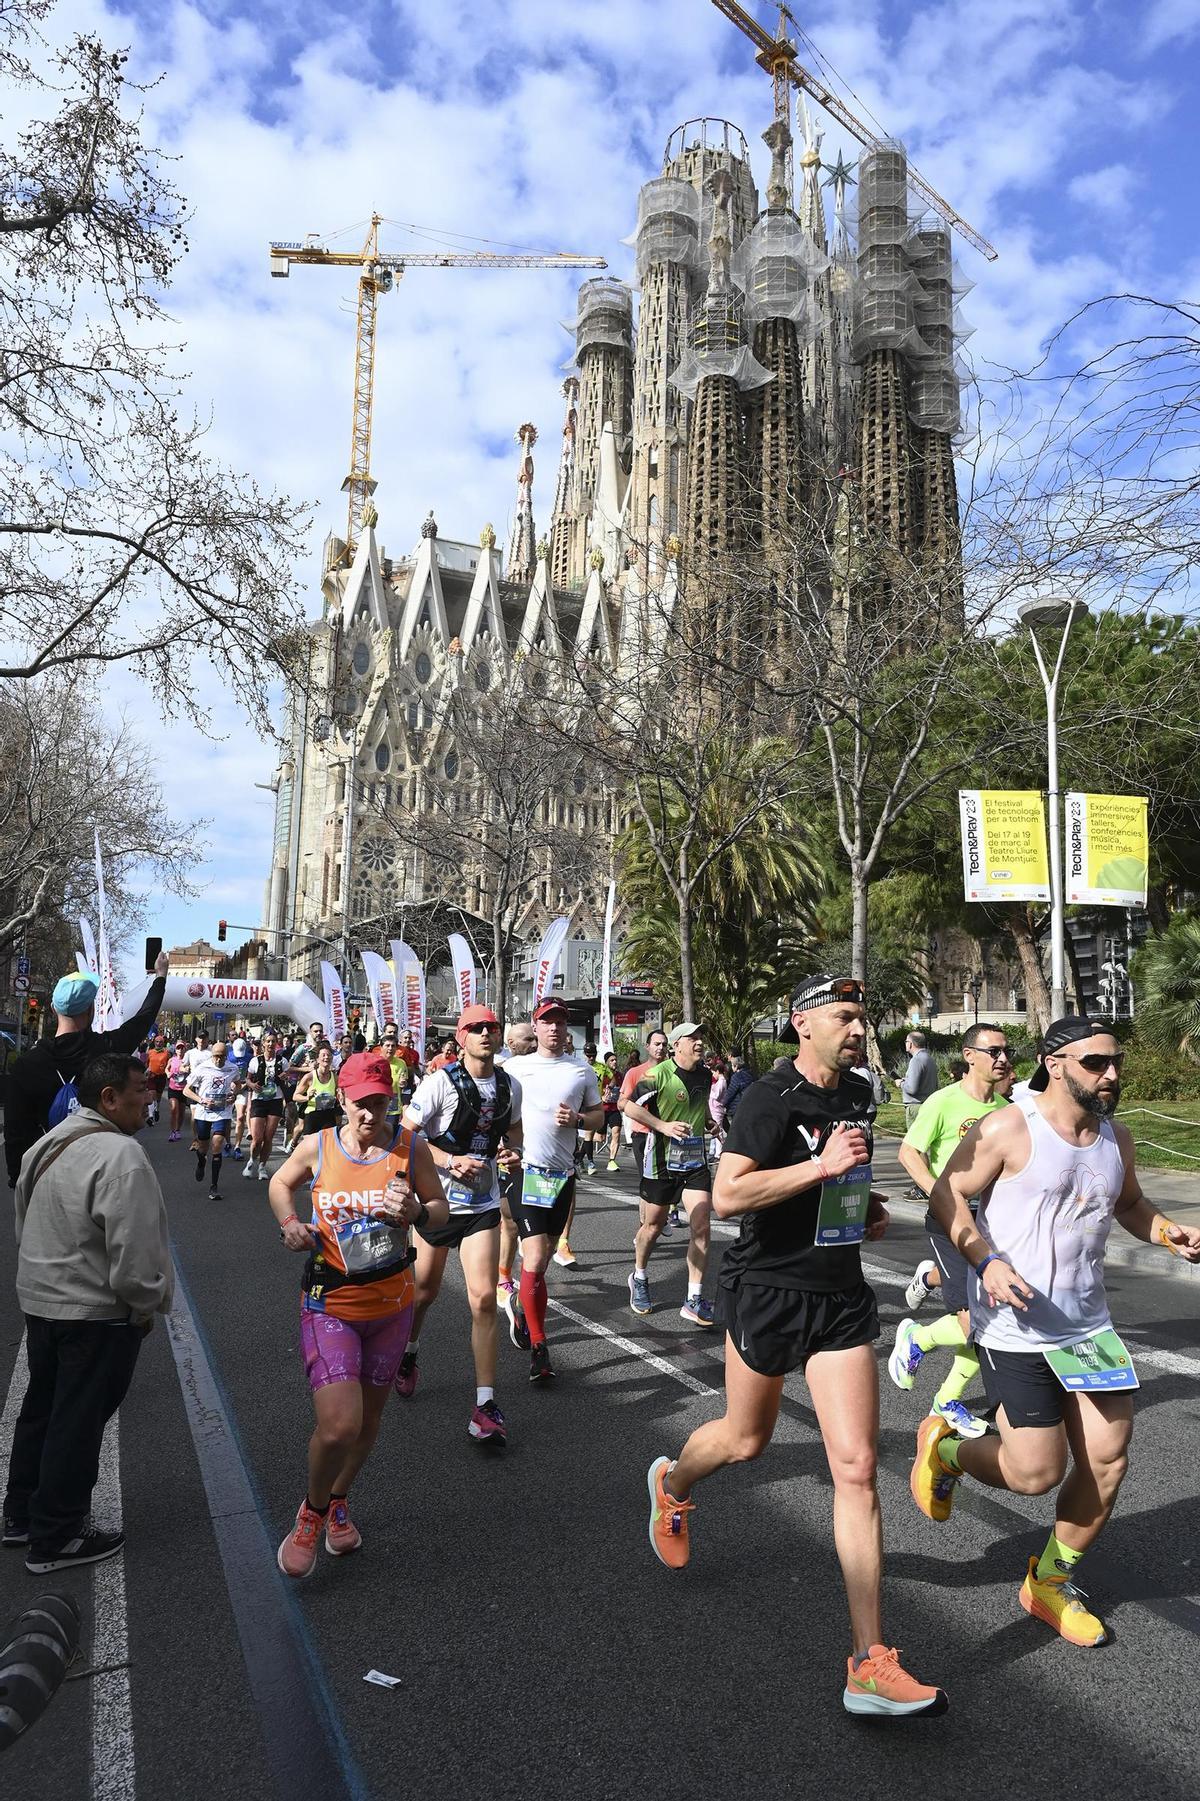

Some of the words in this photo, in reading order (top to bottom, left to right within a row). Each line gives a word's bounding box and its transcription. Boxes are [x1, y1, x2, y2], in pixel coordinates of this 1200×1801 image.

[271, 241, 302, 249] POTAIN
[985, 799, 993, 807] El
[994, 799, 1023, 807] festival
[986, 807, 996, 815] de
[998, 807, 1041, 817] tecnologia
[988, 831, 1000, 839] Del
[1003, 831, 1011, 839] 17
[1013, 831, 1020, 839] al
[1022, 831, 1031, 839] 19
[1095, 843, 1113, 851] molt
[207, 983, 269, 1001] YAMAHA
[318, 1189, 384, 1210] BONE
[1071, 1341, 1098, 1356] JORDI
